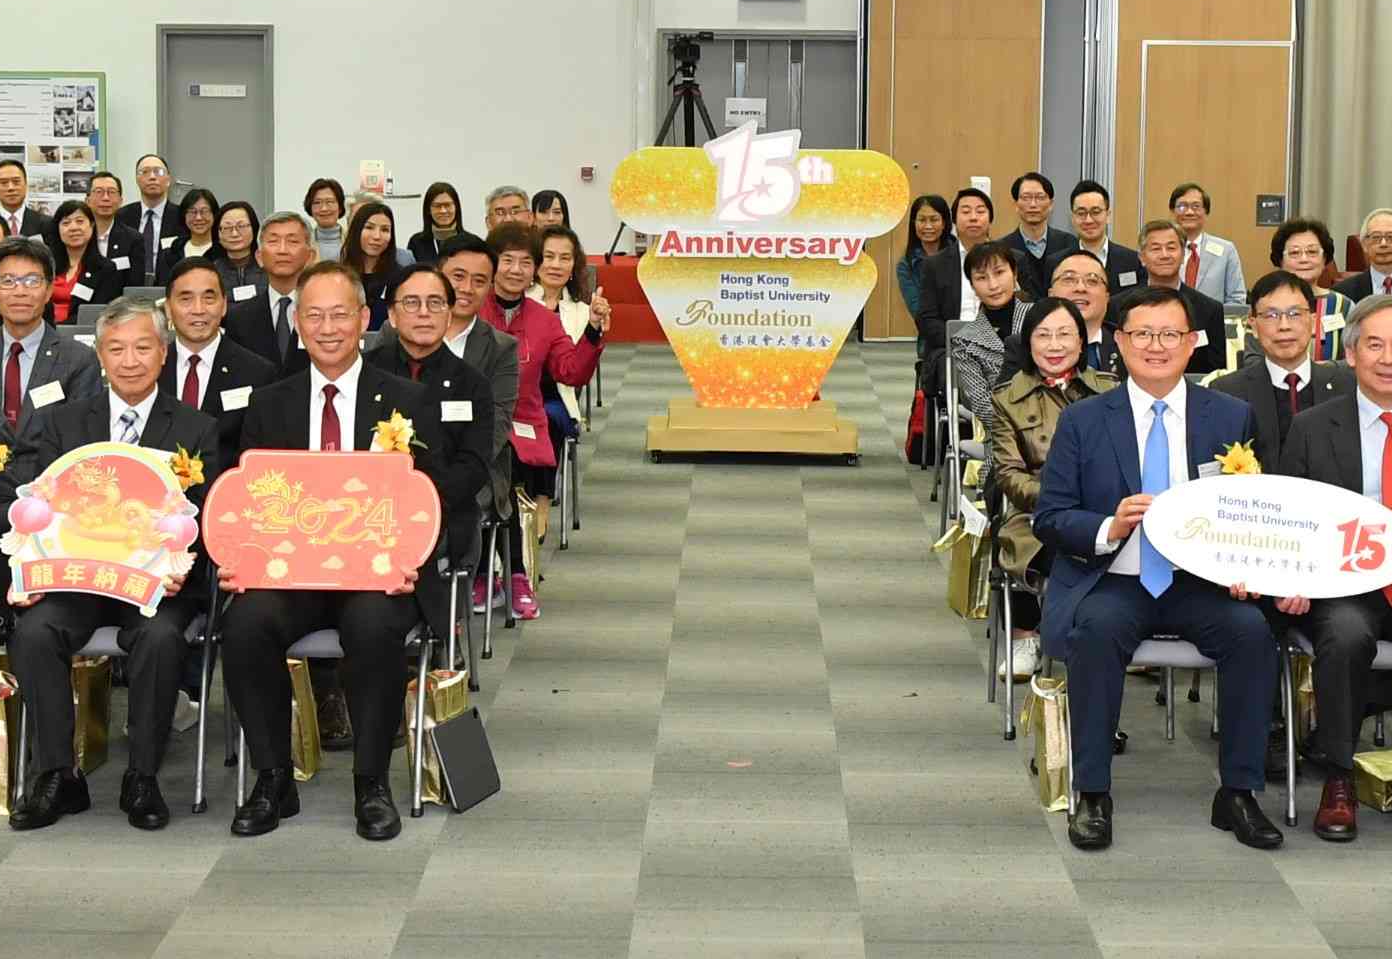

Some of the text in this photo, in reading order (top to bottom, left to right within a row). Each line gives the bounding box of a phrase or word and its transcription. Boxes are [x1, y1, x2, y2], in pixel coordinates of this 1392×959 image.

[660, 230, 862, 261] Anniversary
[720, 274, 790, 287] Hong Kong
[720, 290, 831, 303] Baptist University
[675, 299, 812, 327] Foundation
[258, 496, 397, 537] 2024
[1218, 495, 1282, 512] Hong Kong
[1175, 516, 1302, 553] Foundation
[1217, 509, 1320, 532] Baptist University
[1336, 516, 1387, 572] 15
[30, 562, 151, 599] 龍年納福
